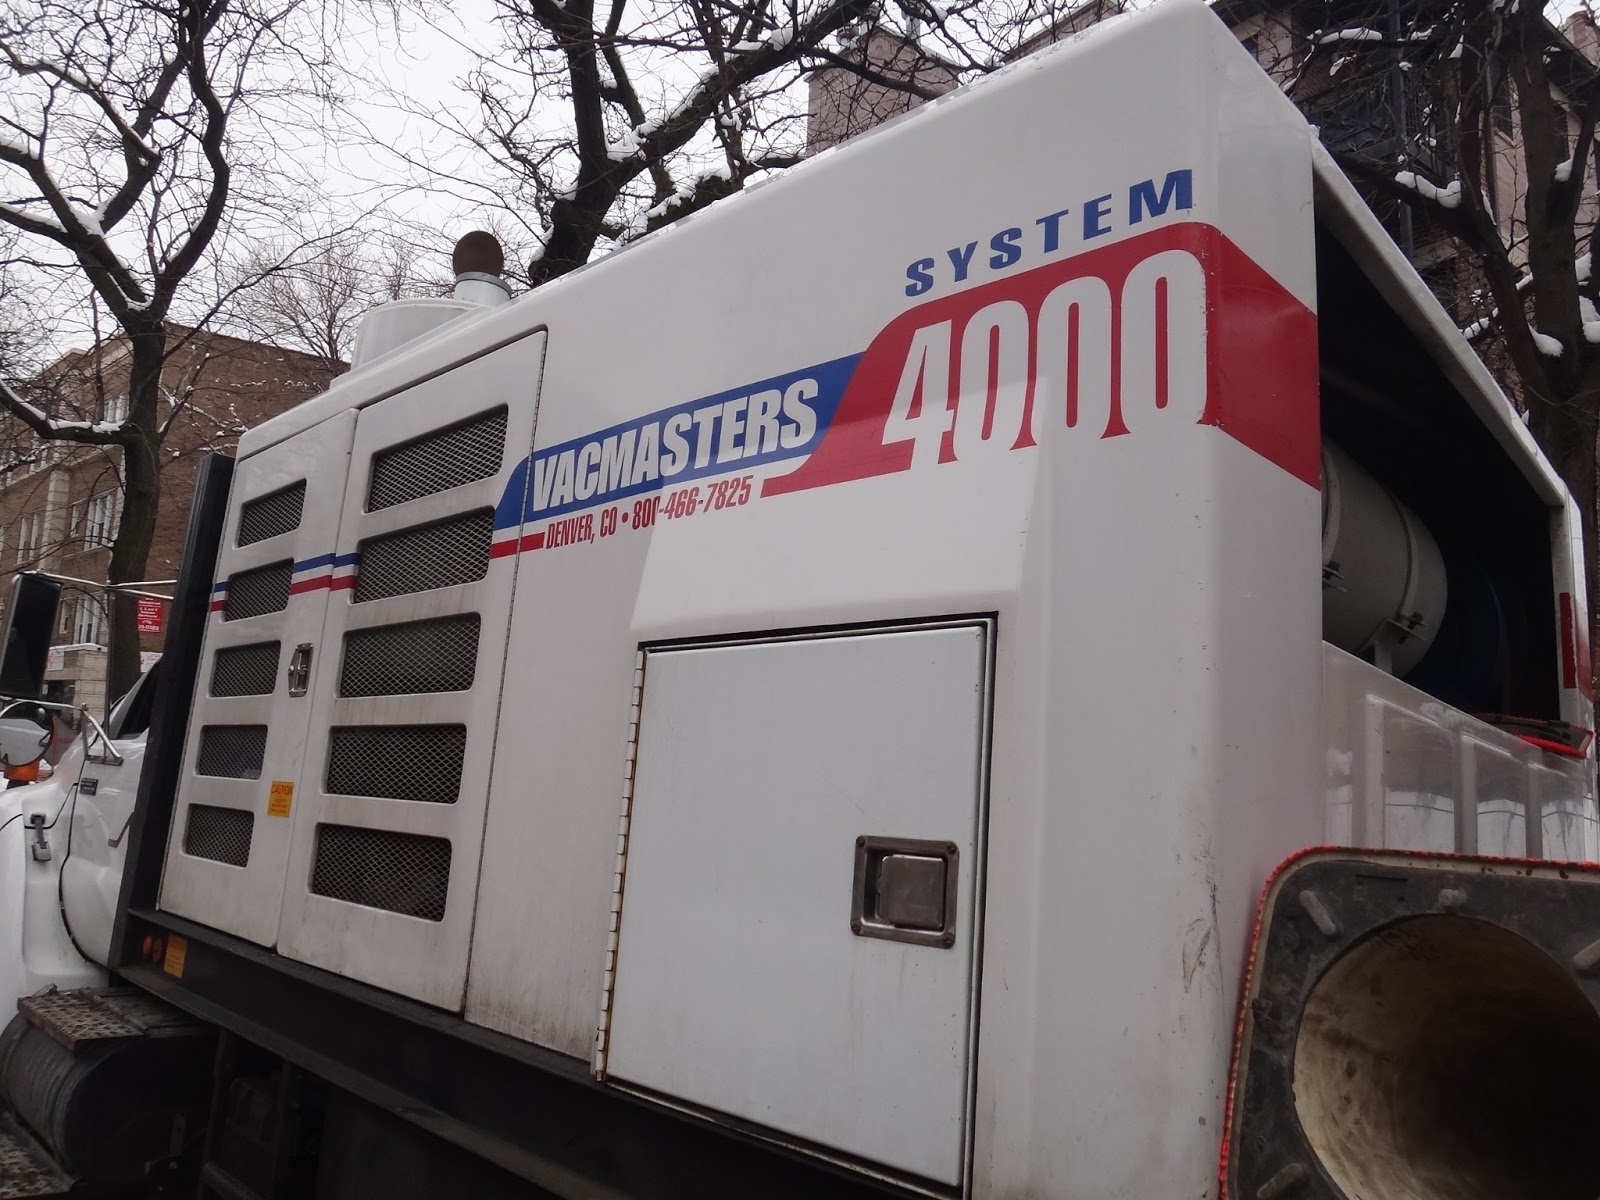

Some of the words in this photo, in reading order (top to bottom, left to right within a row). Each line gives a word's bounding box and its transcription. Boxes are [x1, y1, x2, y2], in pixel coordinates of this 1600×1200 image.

[905, 169, 1192, 297] SYSTEM
[881, 249, 1207, 469] 4000
[532, 378, 818, 512] VACMASTERS
[546, 513, 595, 549] DENVER,
[600, 506, 618, 537] CO
[632, 475, 754, 530] 800-466-7825
